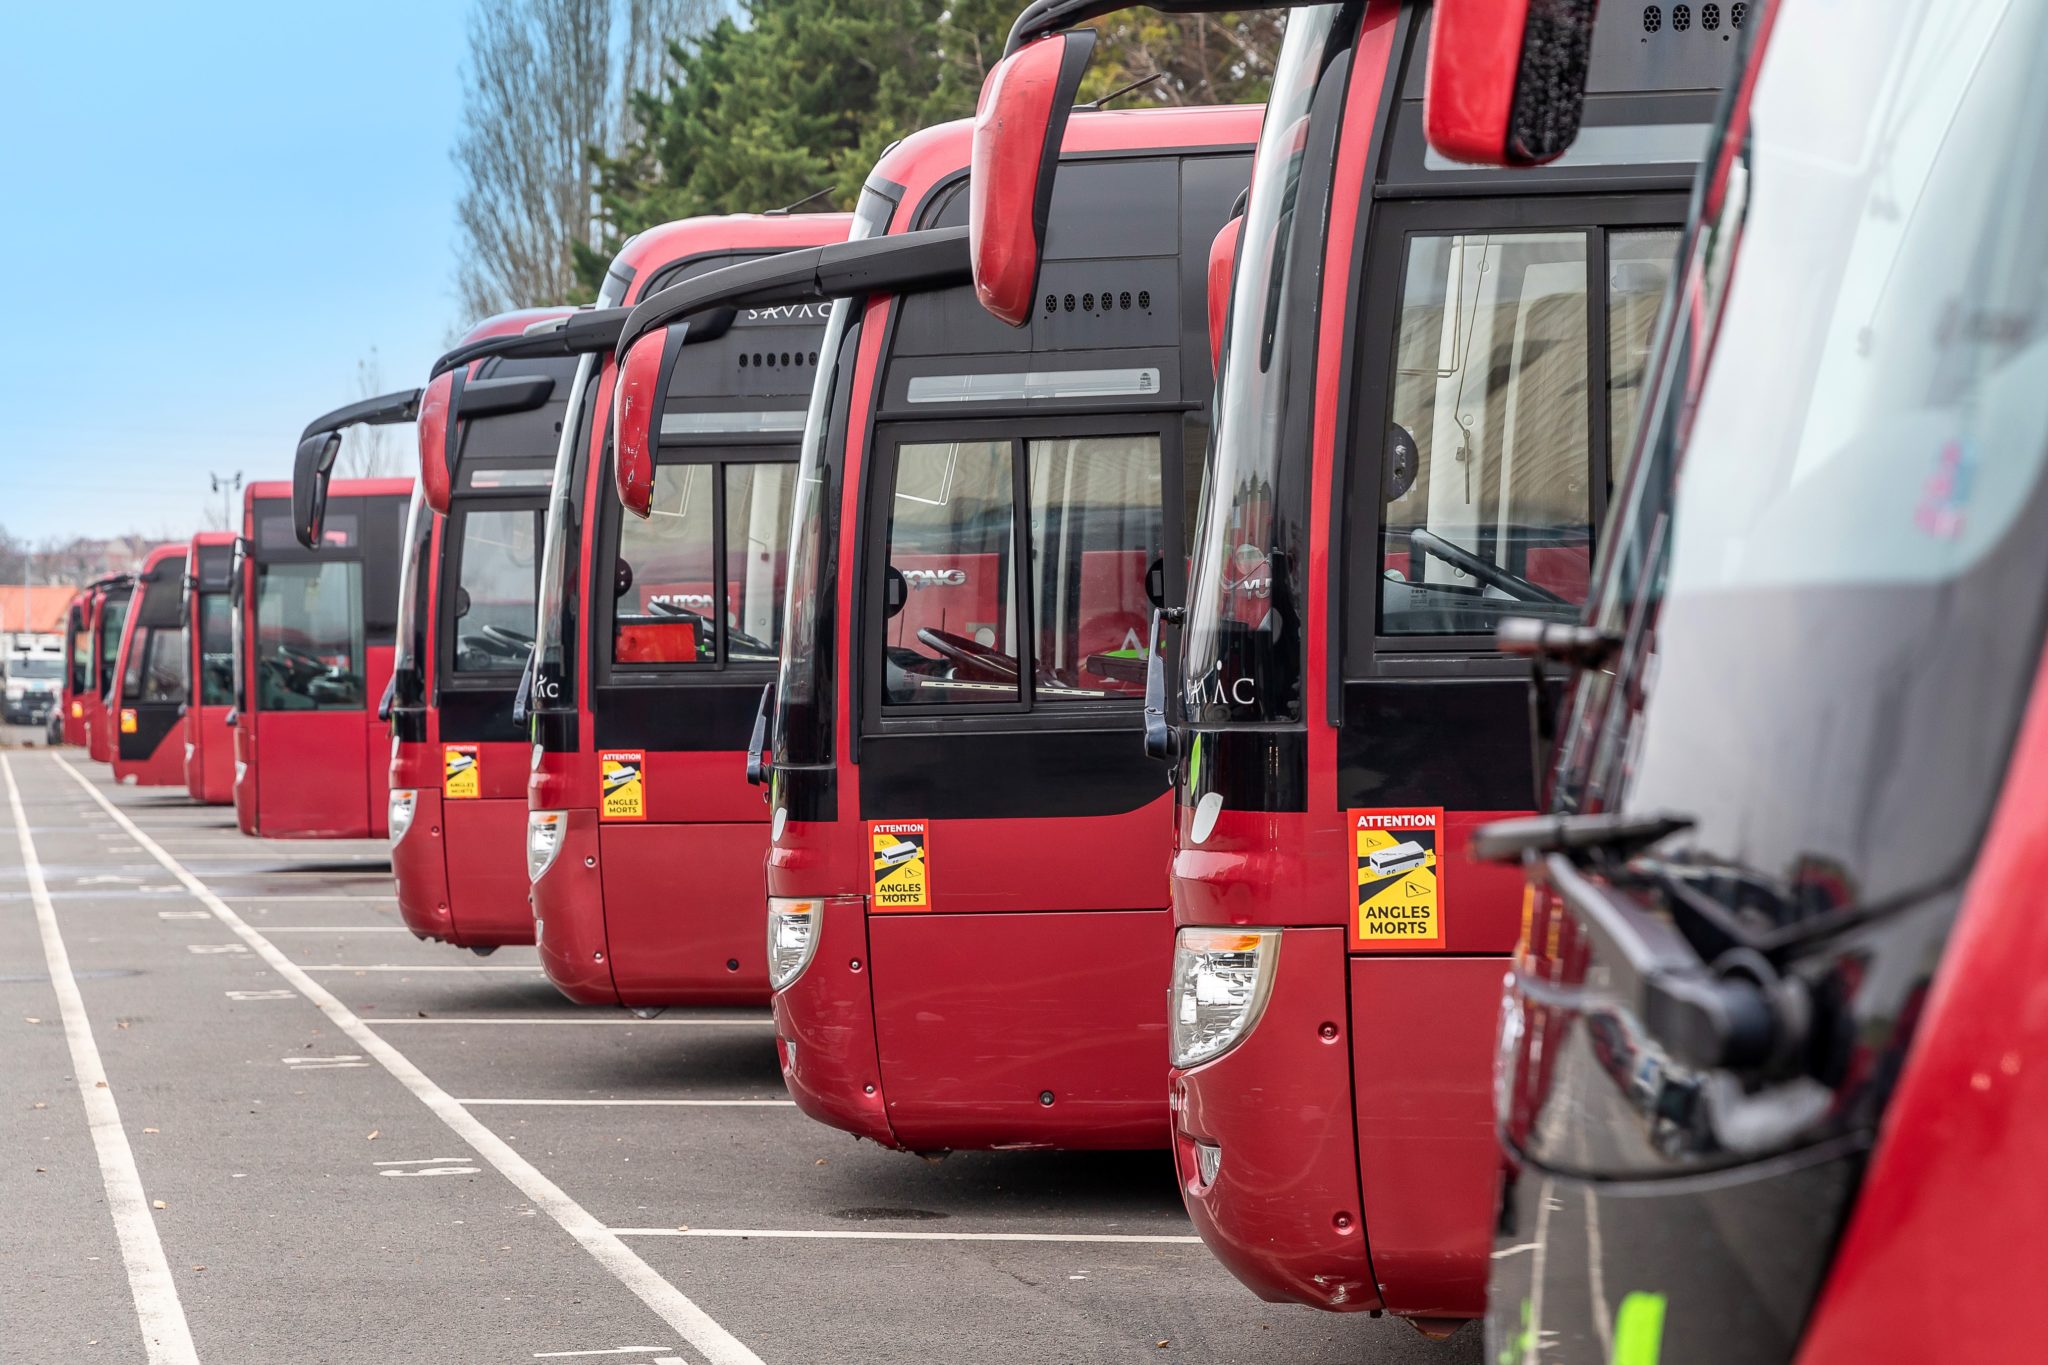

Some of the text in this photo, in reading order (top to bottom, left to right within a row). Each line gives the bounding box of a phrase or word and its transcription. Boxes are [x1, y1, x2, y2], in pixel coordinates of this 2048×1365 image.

[602, 753, 642, 761] ATTENTION
[609, 806, 638, 814] MORTS
[1357, 814, 1436, 828] ATTENTION
[873, 824, 924, 833] ATTENTION
[880, 884, 921, 892] ANGLES
[882, 894, 919, 903] MORTS
[1365, 906, 1430, 919] ANGLES
[1370, 922, 1427, 935] MORTS
[372, 1157, 482, 1176] 19
